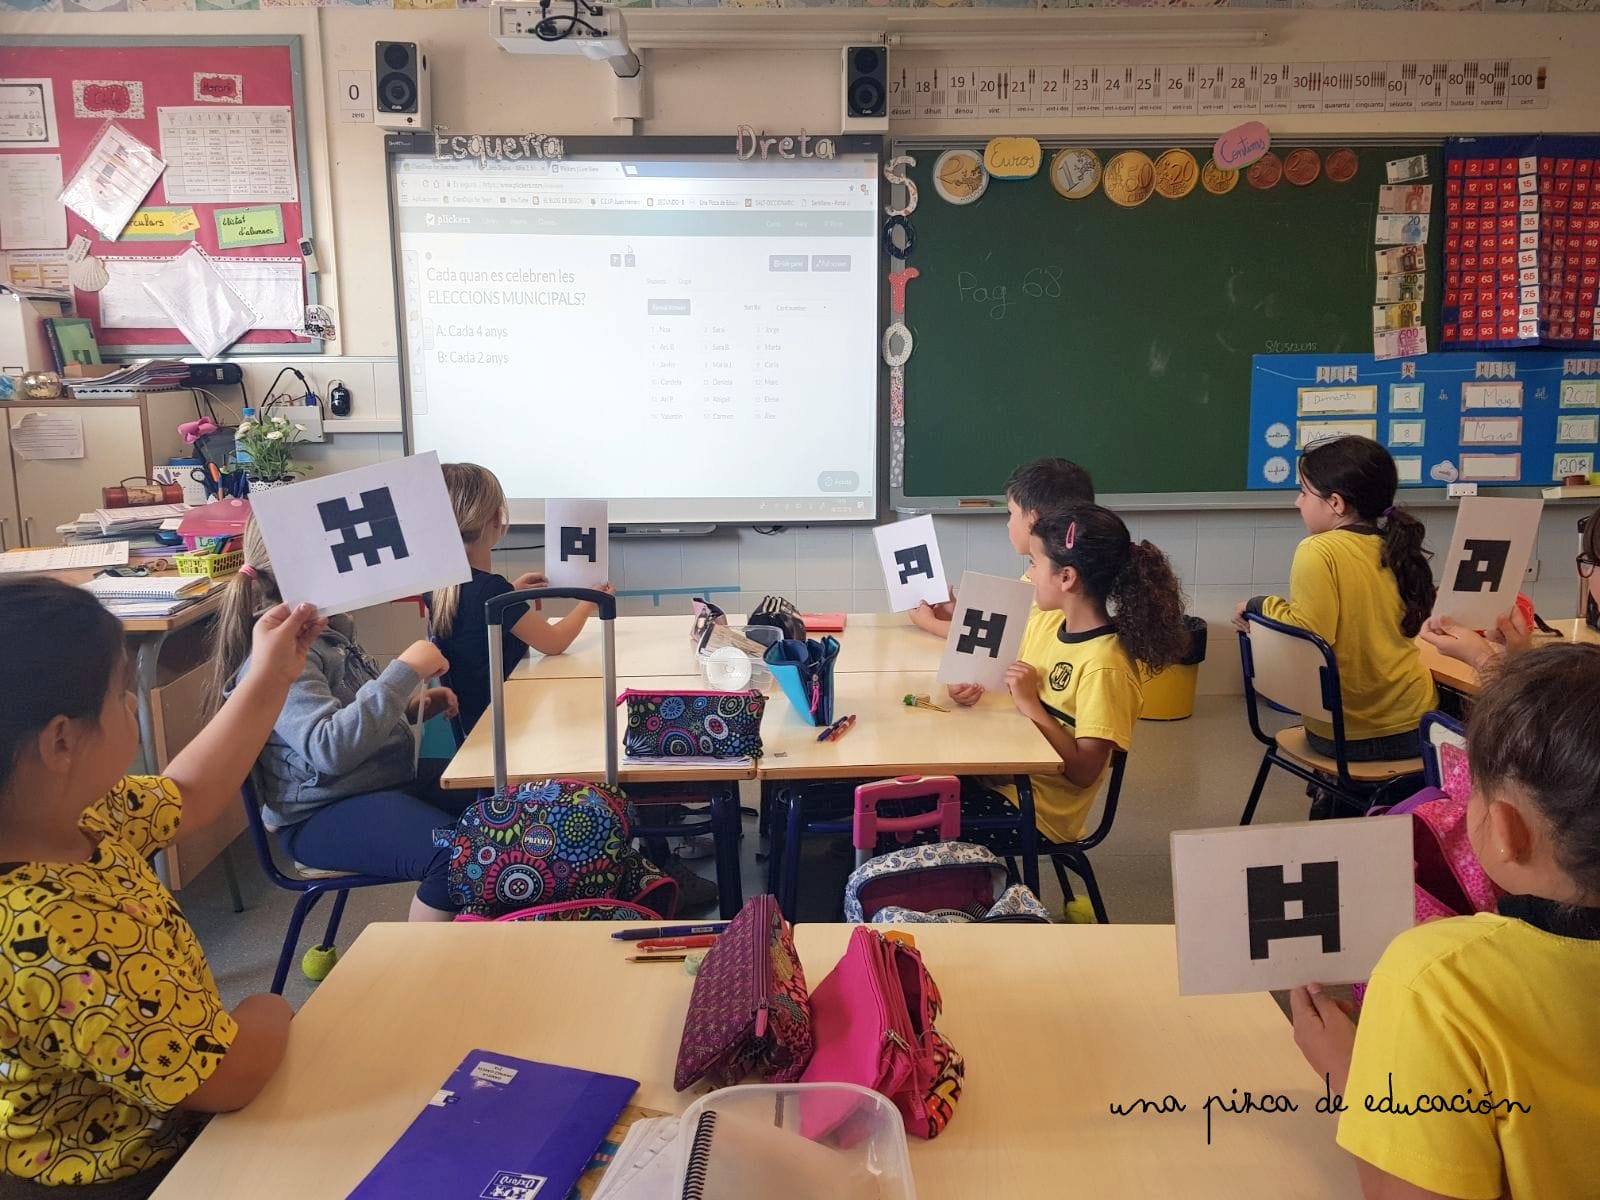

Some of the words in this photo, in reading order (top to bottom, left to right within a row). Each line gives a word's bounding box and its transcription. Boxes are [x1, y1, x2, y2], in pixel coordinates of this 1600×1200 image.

[951, 76, 965, 87] 19
[1168, 78, 1183, 89] 26
[1200, 78, 1215, 89] 27
[1231, 78, 1246, 89] 28
[1263, 73, 1278, 85] 29
[1293, 77, 1308, 88] 30
[1322, 76, 1338, 87] 40
[1355, 75, 1370, 87] 50
[1418, 74, 1433, 86] 70
[1449, 74, 1464, 85] 80
[1479, 73, 1494, 84] 90
[1510, 74, 1533, 86] 100
[916, 81, 930, 92] 18
[980, 80, 995, 92] 20
[1011, 81, 1026, 92] 21
[1043, 80, 1057, 92] 22
[1074, 79, 1089, 91] 23
[1105, 79, 1120, 90] 24
[1137, 78, 1152, 90] 25
[1387, 80, 1403, 92] 60
[349, 84, 360, 101] 0
[1324, 102, 1350, 110] quaranta
[1355, 101, 1385, 110] cinquanta
[433, 126, 564, 168] Esquerra
[736, 124, 836, 161] Dreta
[991, 142, 1035, 169] Euros
[936, 157, 963, 184] 2
[1170, 161, 1193, 184] 20
[1059, 160, 1079, 192] 1
[1125, 162, 1152, 193] 50
[1468, 183, 1477, 192] 12
[1484, 183, 1494, 191] 13
[1502, 182, 1512, 190] 14
[1522, 179, 1532, 188] 15
[1465, 201, 1476, 210] 22
[1483, 201, 1495, 210] 23
[1502, 200, 1515, 209] 24
[1522, 198, 1535, 207] 25
[437, 214, 471, 226] plickers
[1408, 216, 1420, 226] 20
[1482, 220, 1494, 230] 33
[1502, 219, 1514, 229] 34
[1523, 217, 1536, 226] 35
[1465, 221, 1476, 230] 32
[1463, 239, 1475, 248] 42
[1482, 239, 1495, 247] 43
[1501, 237, 1515, 246] 44
[1522, 236, 1535, 244] 45
[1464, 257, 1476, 266] 52
[1482, 256, 1495, 265] 53
[1501, 256, 1514, 265] 54
[1521, 254, 1534, 263] 55
[427, 268, 457, 282] Cada
[459, 270, 488, 285] quan
[490, 272, 504, 282] es
[506, 268, 556, 283] celebren
[559, 268, 575, 283] les
[1403, 275, 1418, 285] 100
[1464, 275, 1476, 284] 62
[1480, 274, 1493, 284] 63
[1502, 273, 1515, 282] 64
[1523, 272, 1536, 281] 65
[1022, 267, 1063, 297] 68
[428, 290, 500, 305] ELECCIONS
[502, 291, 586, 306] MUNICIPALS?
[1463, 292, 1473, 301] 72
[1481, 292, 1493, 301] 73
[1501, 291, 1514, 300] 74
[1524, 289, 1536, 298] 75
[1401, 302, 1417, 312] 200
[1522, 307, 1535, 316] 85
[1462, 310, 1473, 319] 82
[1481, 309, 1494, 318] 83
[1502, 308, 1515, 317] 84
[436, 325, 446, 337] A:
[449, 325, 474, 338] Cada
[476, 325, 483, 337] 4
[485, 327, 509, 340] anys
[1462, 328, 1474, 336] 92
[1481, 327, 1493, 336] 93
[1501, 326, 1514, 335] 94
[1521, 324, 1534, 334] 95
[437, 351, 448, 363] B:
[450, 351, 475, 364] Cada
[477, 351, 484, 363] 2
[486, 353, 509, 367] anys
[1320, 366, 1356, 378] DIA
[1480, 361, 1512, 373] MES
[524, 836, 553, 846] PRIVATA
[500, 1176, 536, 1191] Oxford
